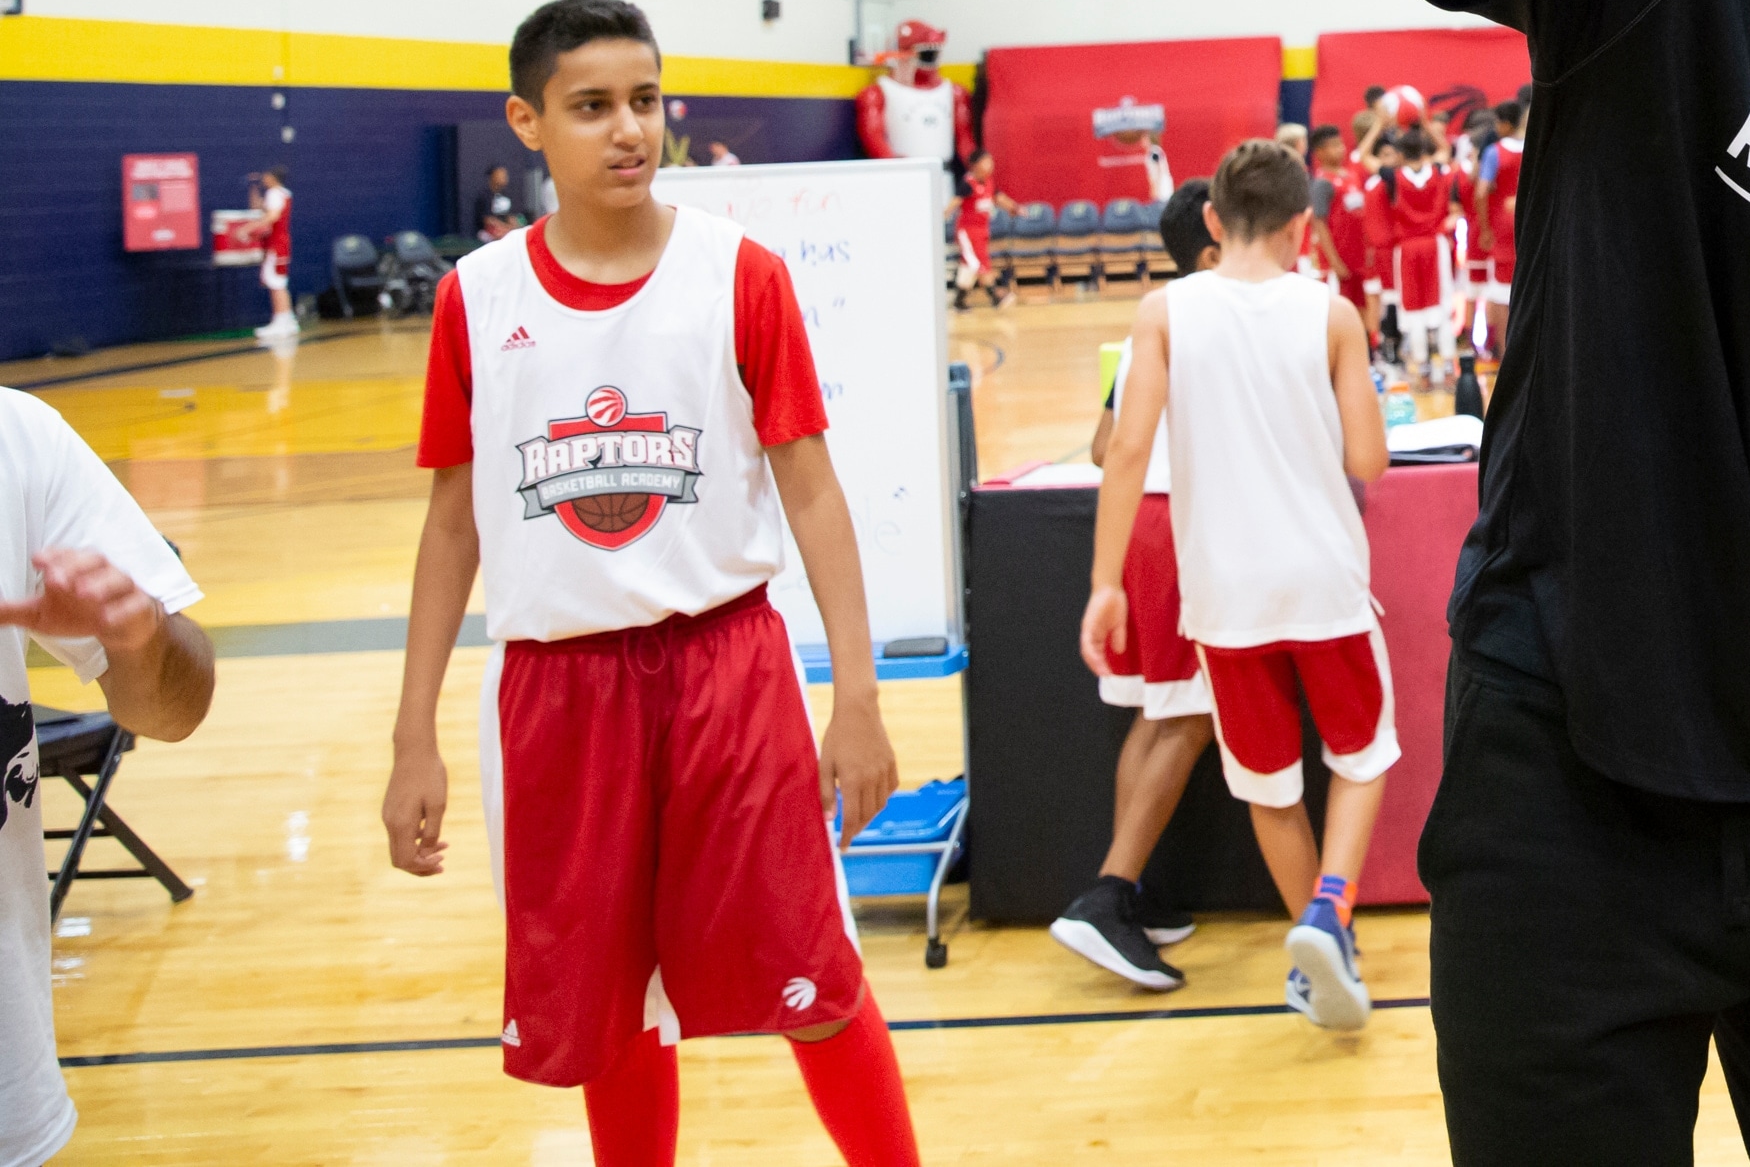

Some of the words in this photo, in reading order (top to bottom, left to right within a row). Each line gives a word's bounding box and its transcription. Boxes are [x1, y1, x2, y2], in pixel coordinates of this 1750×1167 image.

[522, 429, 697, 485] RAPTORS
[542, 473, 617, 501] BASKETBALL
[621, 472, 682, 490] ACADEMY
